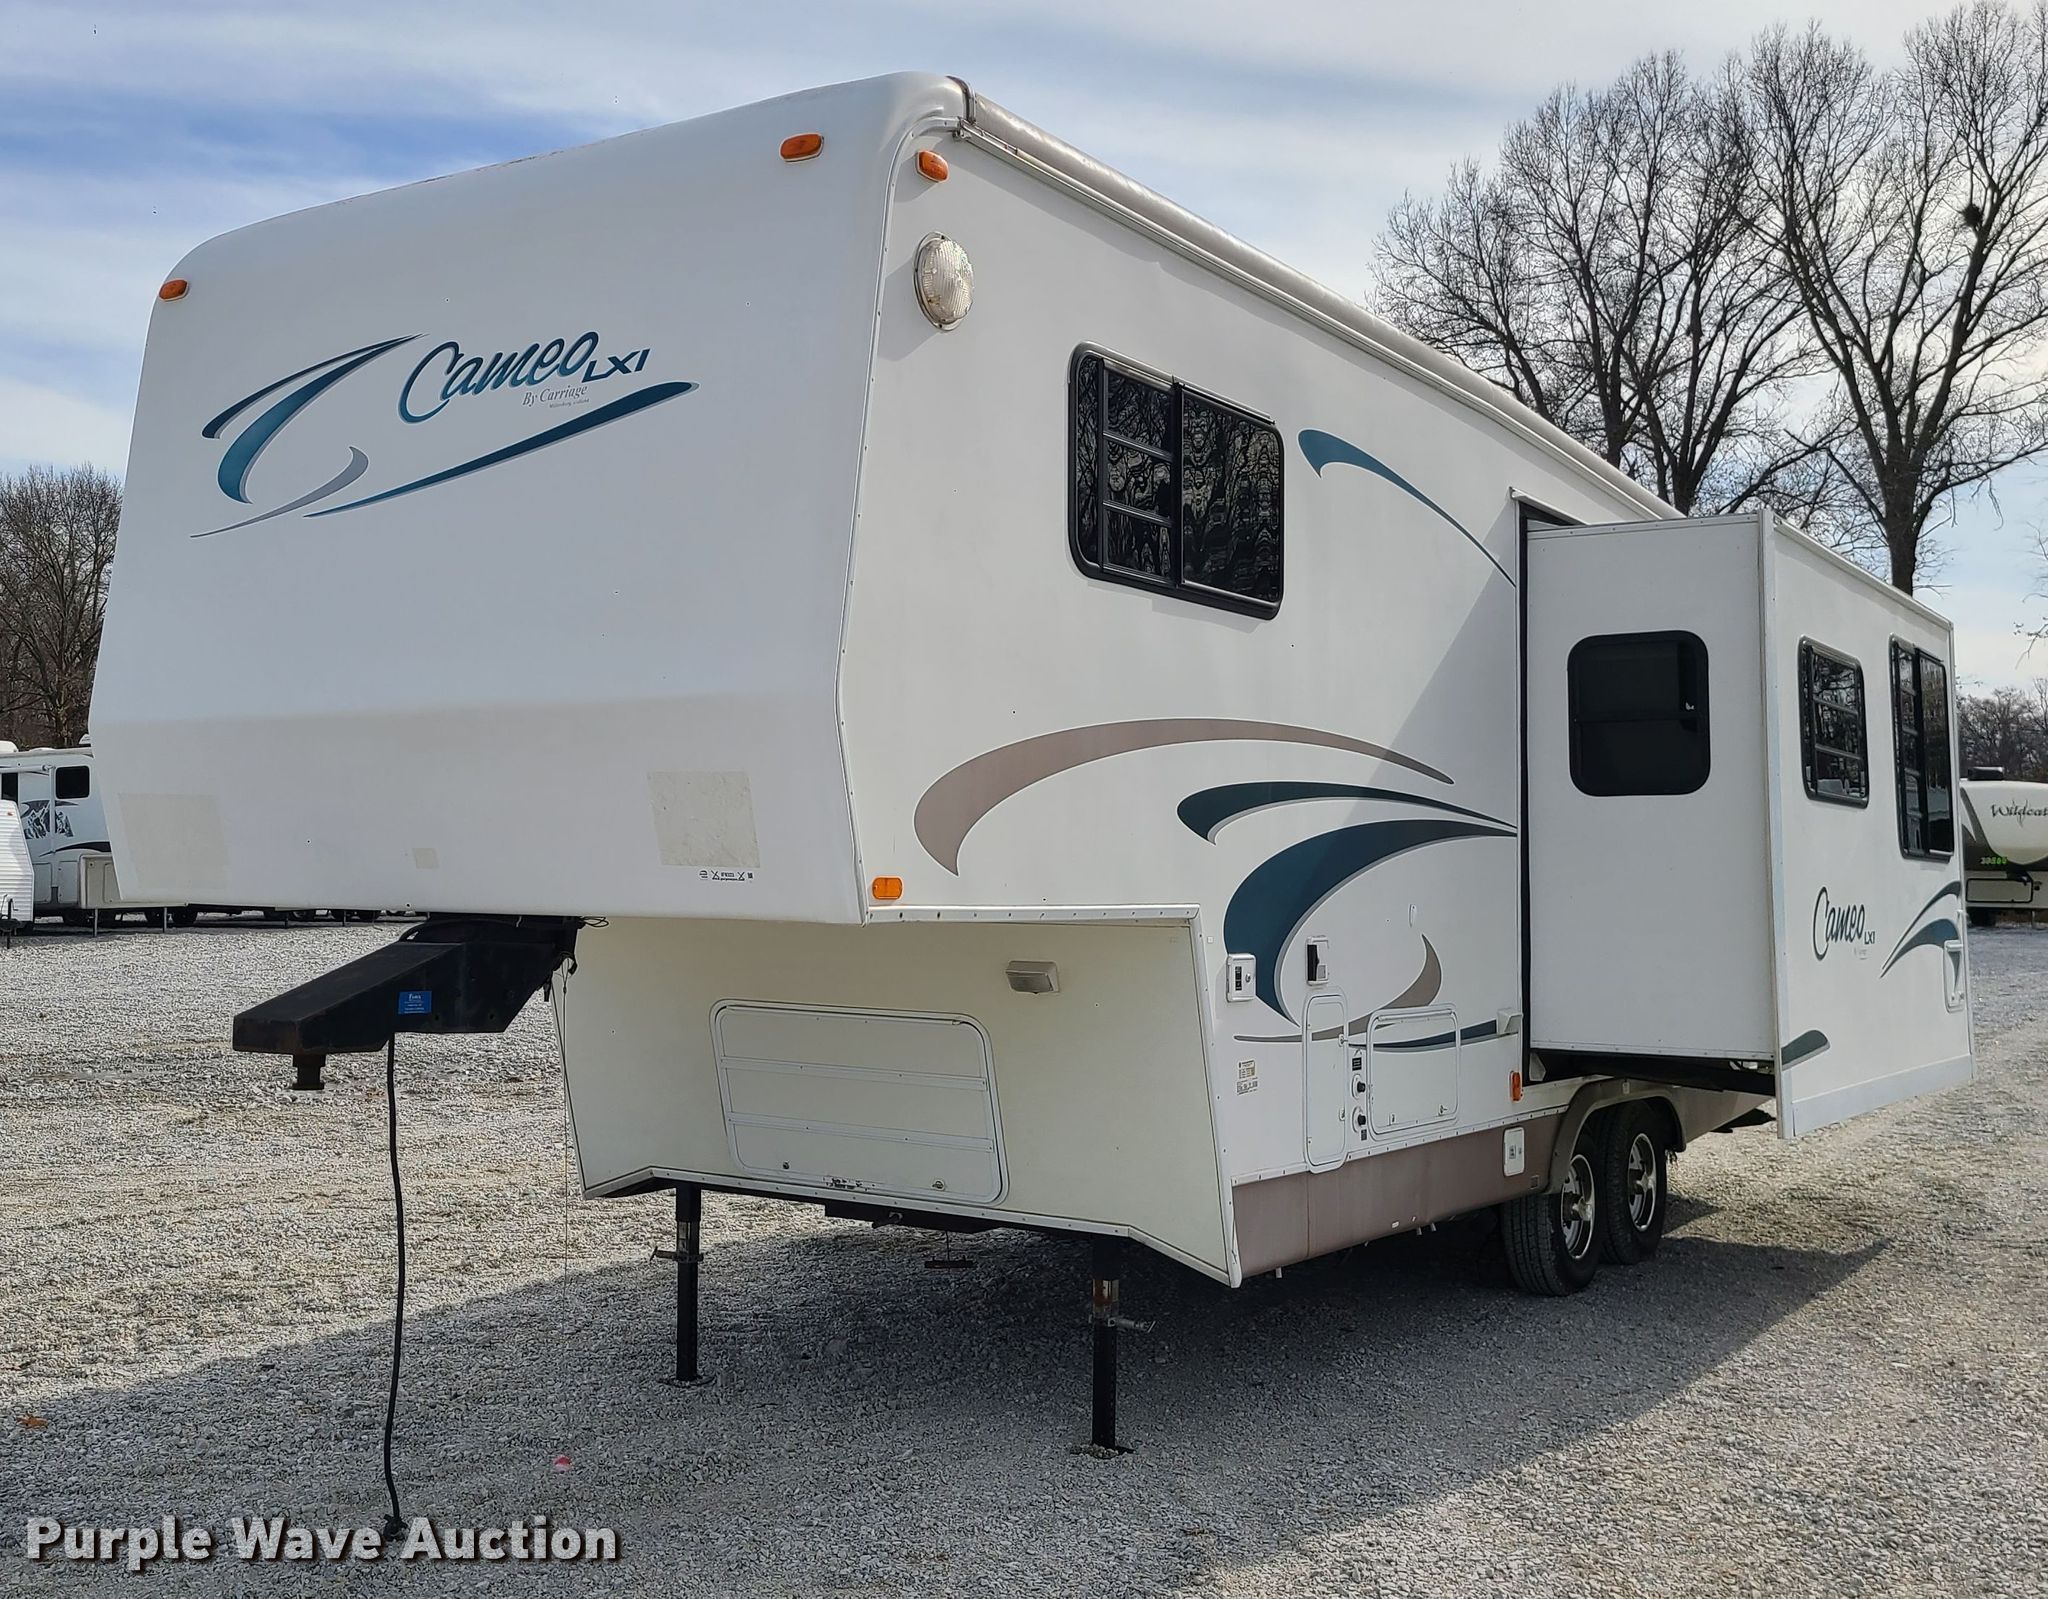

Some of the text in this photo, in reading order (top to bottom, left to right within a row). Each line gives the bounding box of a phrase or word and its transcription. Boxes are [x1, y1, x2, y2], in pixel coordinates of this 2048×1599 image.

[399, 332, 650, 423] Cameo LXI
[523, 391, 538, 406] By
[540, 385, 588, 402] Carriage
[1812, 886, 1865, 961] Cameo
